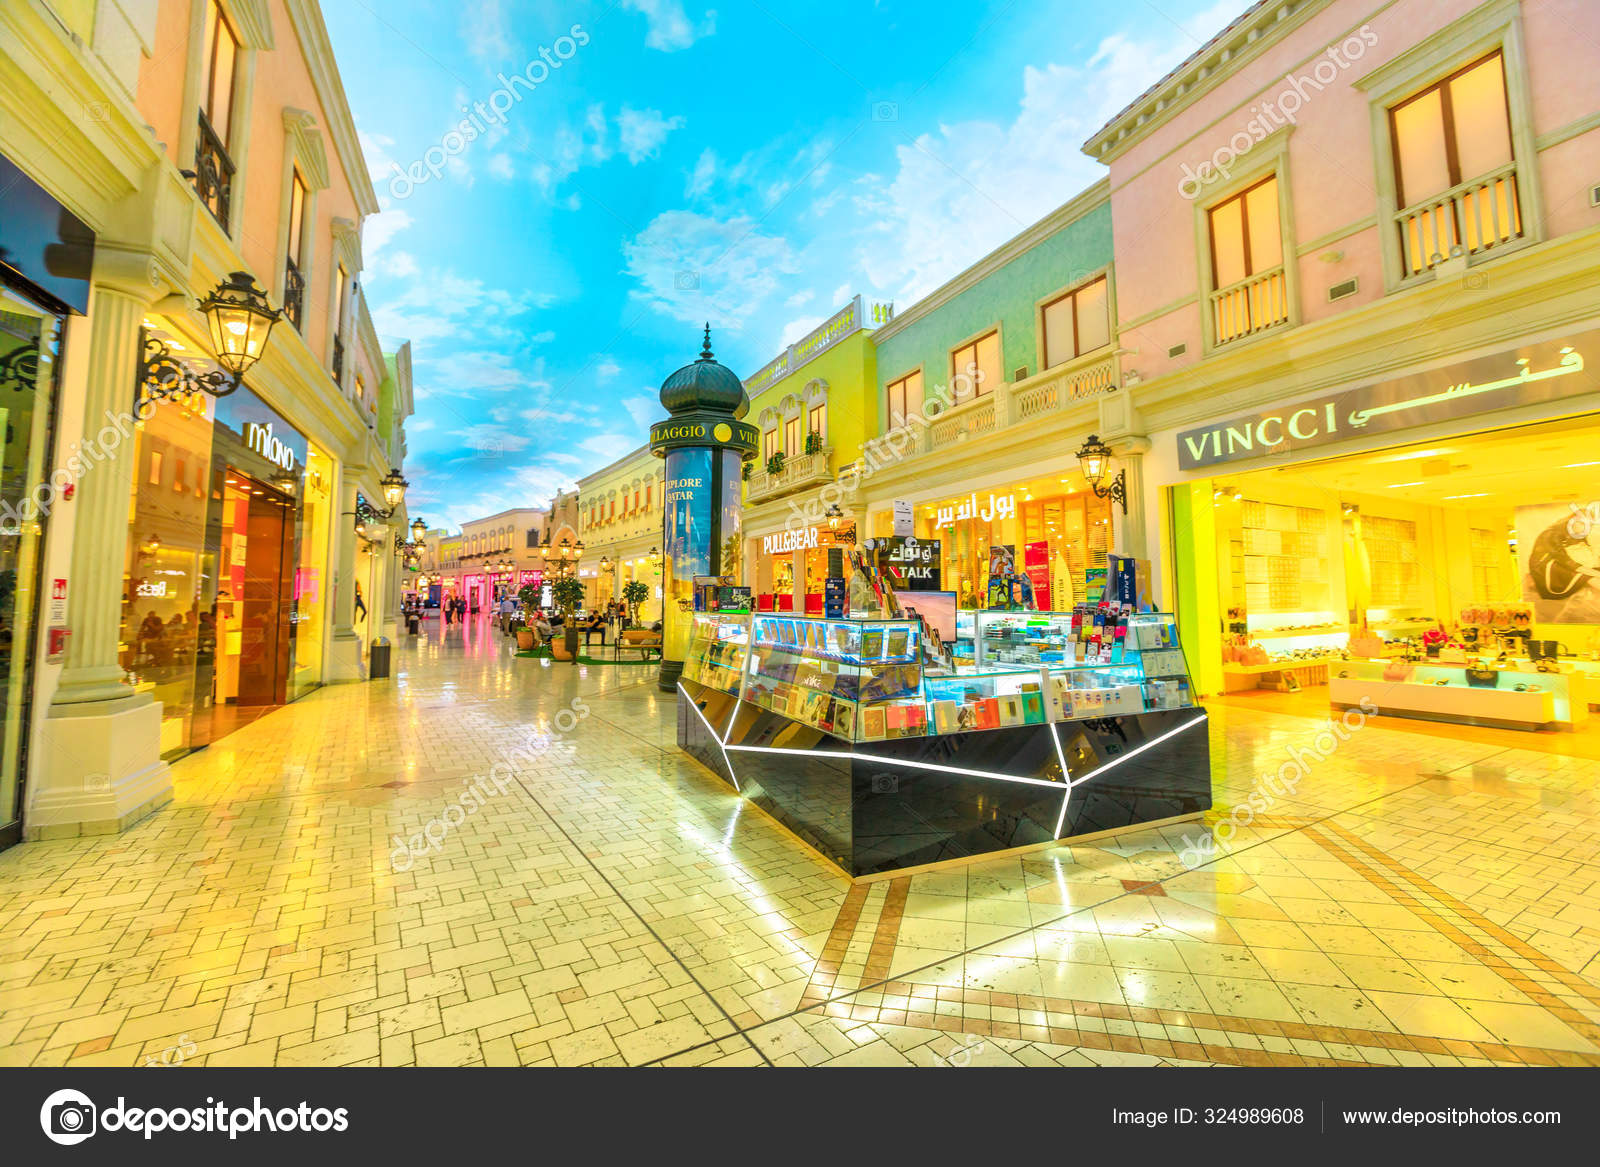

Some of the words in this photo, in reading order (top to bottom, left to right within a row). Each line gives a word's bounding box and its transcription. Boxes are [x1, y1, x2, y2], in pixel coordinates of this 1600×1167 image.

[650, 425, 705, 442] LAGGIO
[1184, 402, 1338, 461] VINCCI
[763, 527, 818, 555] PULL&BEAR
